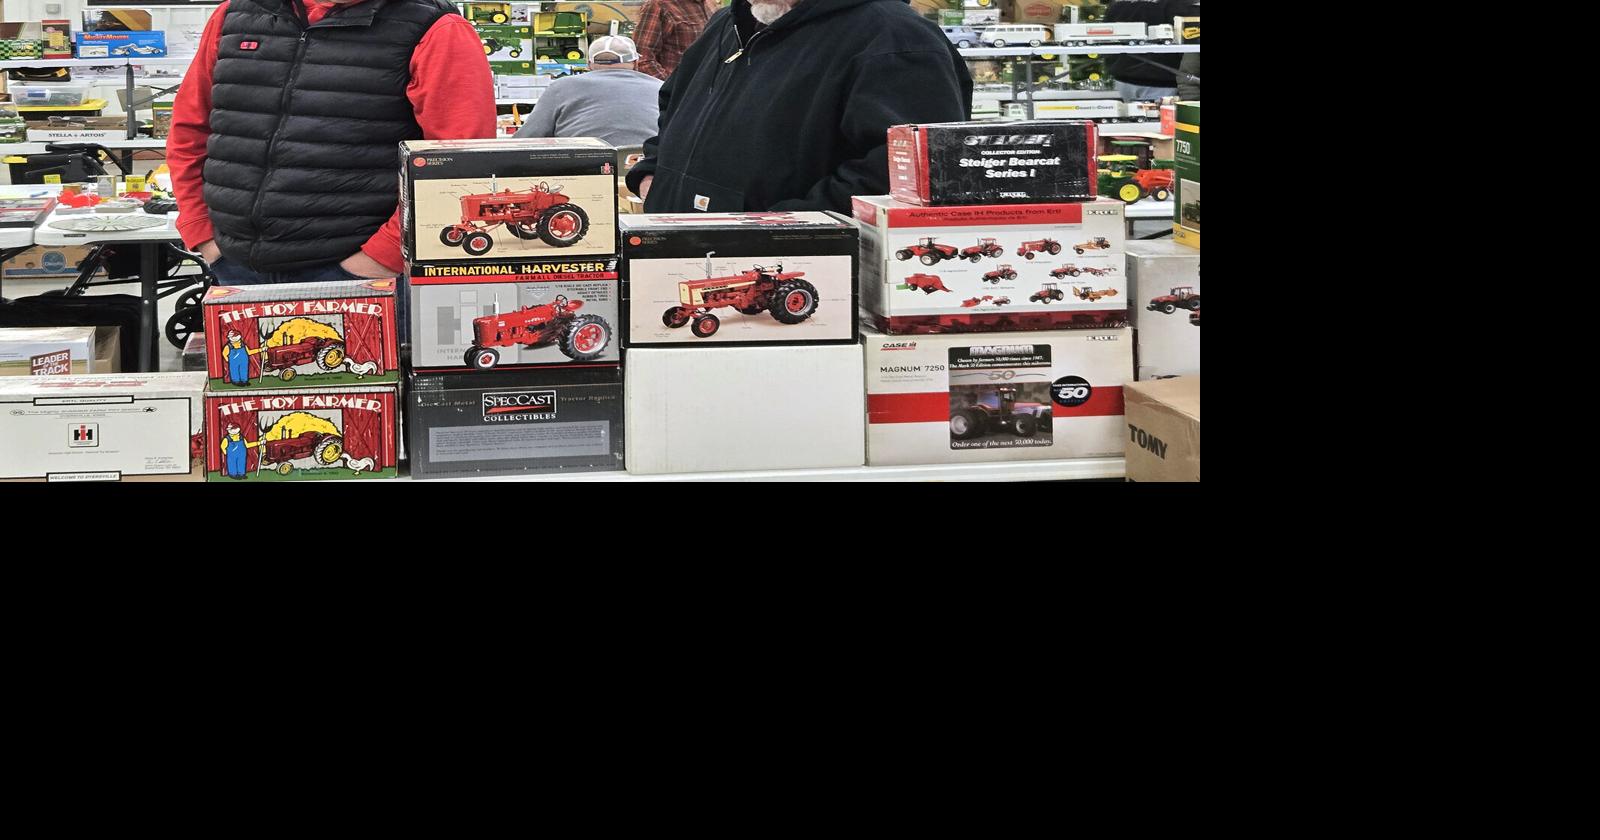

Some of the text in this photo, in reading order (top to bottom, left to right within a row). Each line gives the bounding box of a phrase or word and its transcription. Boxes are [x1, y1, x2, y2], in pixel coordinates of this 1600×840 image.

[959, 157, 1061, 169] Steiger Bearcat
[984, 168, 1037, 178] Series I
[424, 263, 605, 277] INTERNATIONAL HARVESTER
[219, 300, 383, 323] THE TOY FARMER
[32, 352, 69, 367] LEADER
[32, 363, 69, 375] TRACK
[880, 364, 945, 373] MAGNUM 7250
[988, 370, 1016, 381] 50
[1058, 386, 1089, 399] 50
[218, 395, 382, 416] THE TOY FARMER
[483, 412, 557, 422] COLLECTIBLES
[982, 440, 989, 449] of
[1015, 438, 1033, 446] 50,000
[1128, 423, 1168, 460] TOMY
